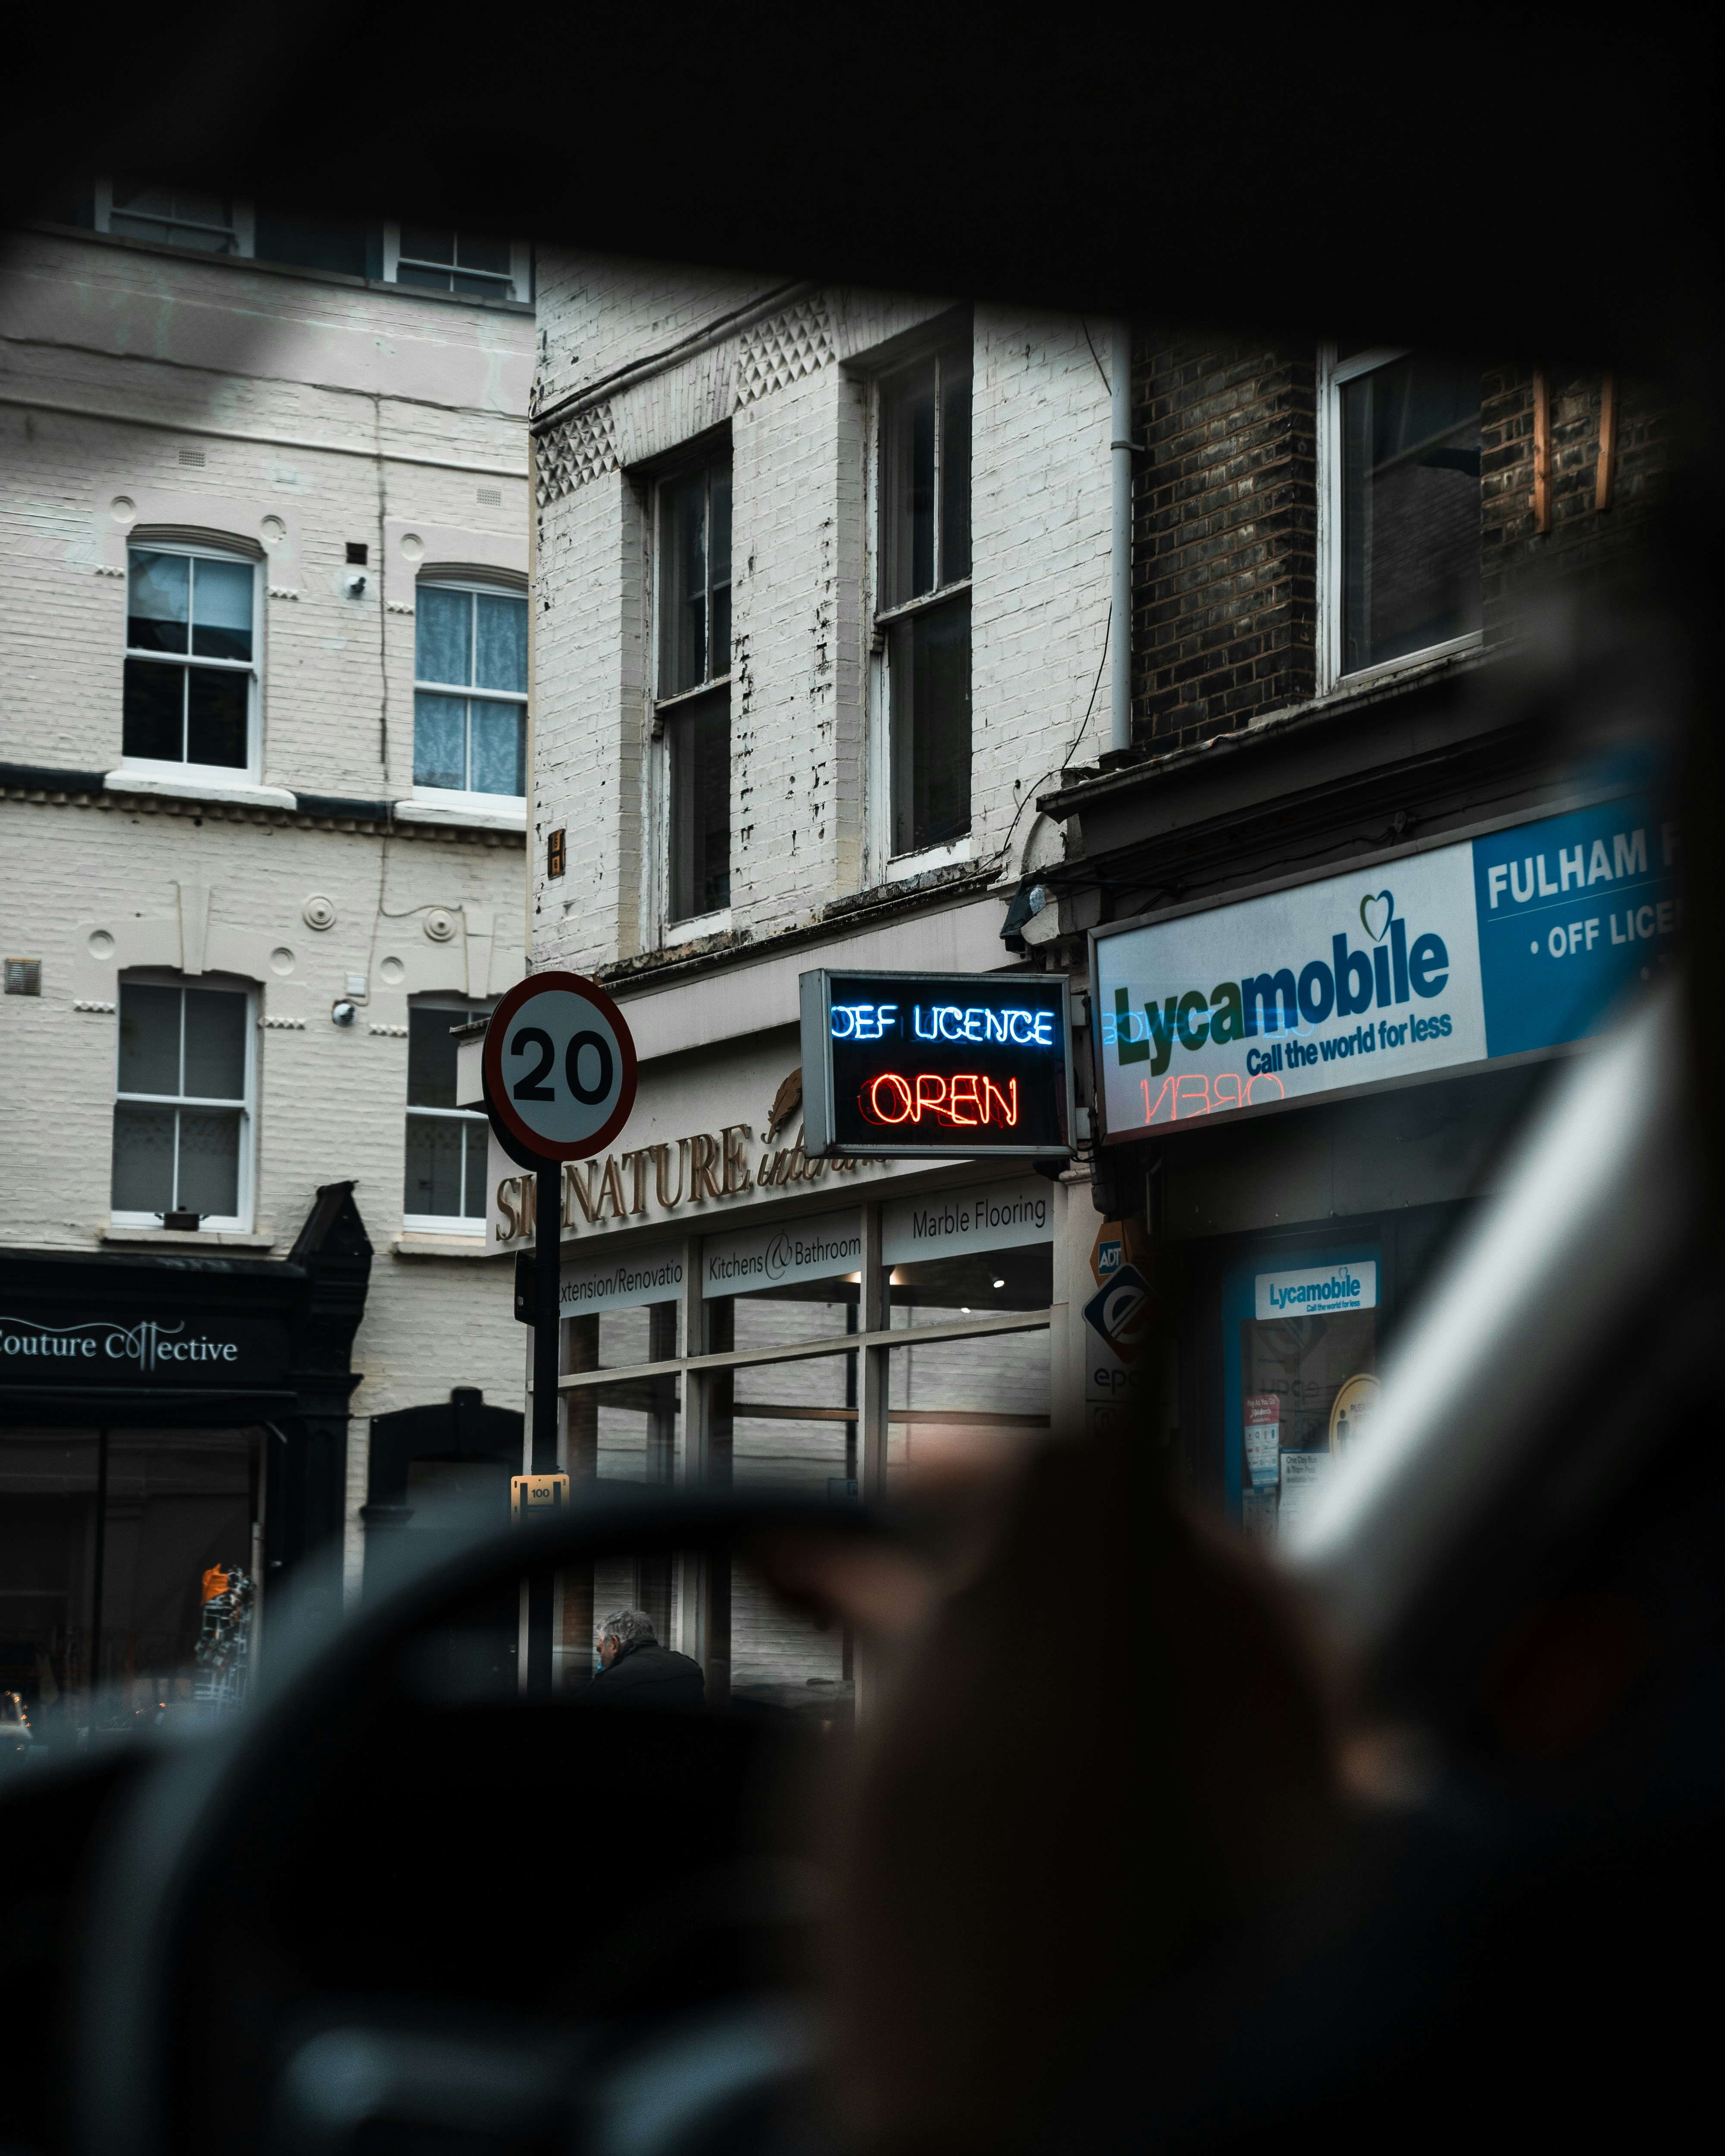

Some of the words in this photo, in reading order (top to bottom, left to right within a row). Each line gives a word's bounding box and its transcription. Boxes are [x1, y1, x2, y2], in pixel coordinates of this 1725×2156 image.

[1488, 828, 1648, 909] FULHAM
[1548, 917, 1600, 958] OFF
[1114, 890, 1449, 1077] Lycamobile
[511, 1027, 614, 1105] 20
[1247, 1044, 1283, 1076] Call
[1285, 1040, 1318, 1069] the
[1320, 1023, 1376, 1061] world
[1379, 1020, 1408, 1049] for
[1410, 1014, 1453, 1043] less
[872, 1074, 1016, 1125] OPEN
[496, 1124, 751, 1242] SINATURE
[913, 1201, 969, 1239] Marble
[975, 1195, 1046, 1229] Flooring
[709, 1252, 763, 1281] Kitchens
[795, 1236, 861, 1266] Bathroom
[1099, 1247, 1121, 1269] ADT
[559, 1260, 683, 1303] xtension/Renovatio
[1270, 1267, 1361, 1309] Lycamobile
[1307, 1304, 1317, 1312] Call
[1327, 1301, 1341, 1310] world
[0, 1329, 97, 1357] outure
[104, 1321, 238, 1371] Collective
[531, 1489, 550, 1498] 100
